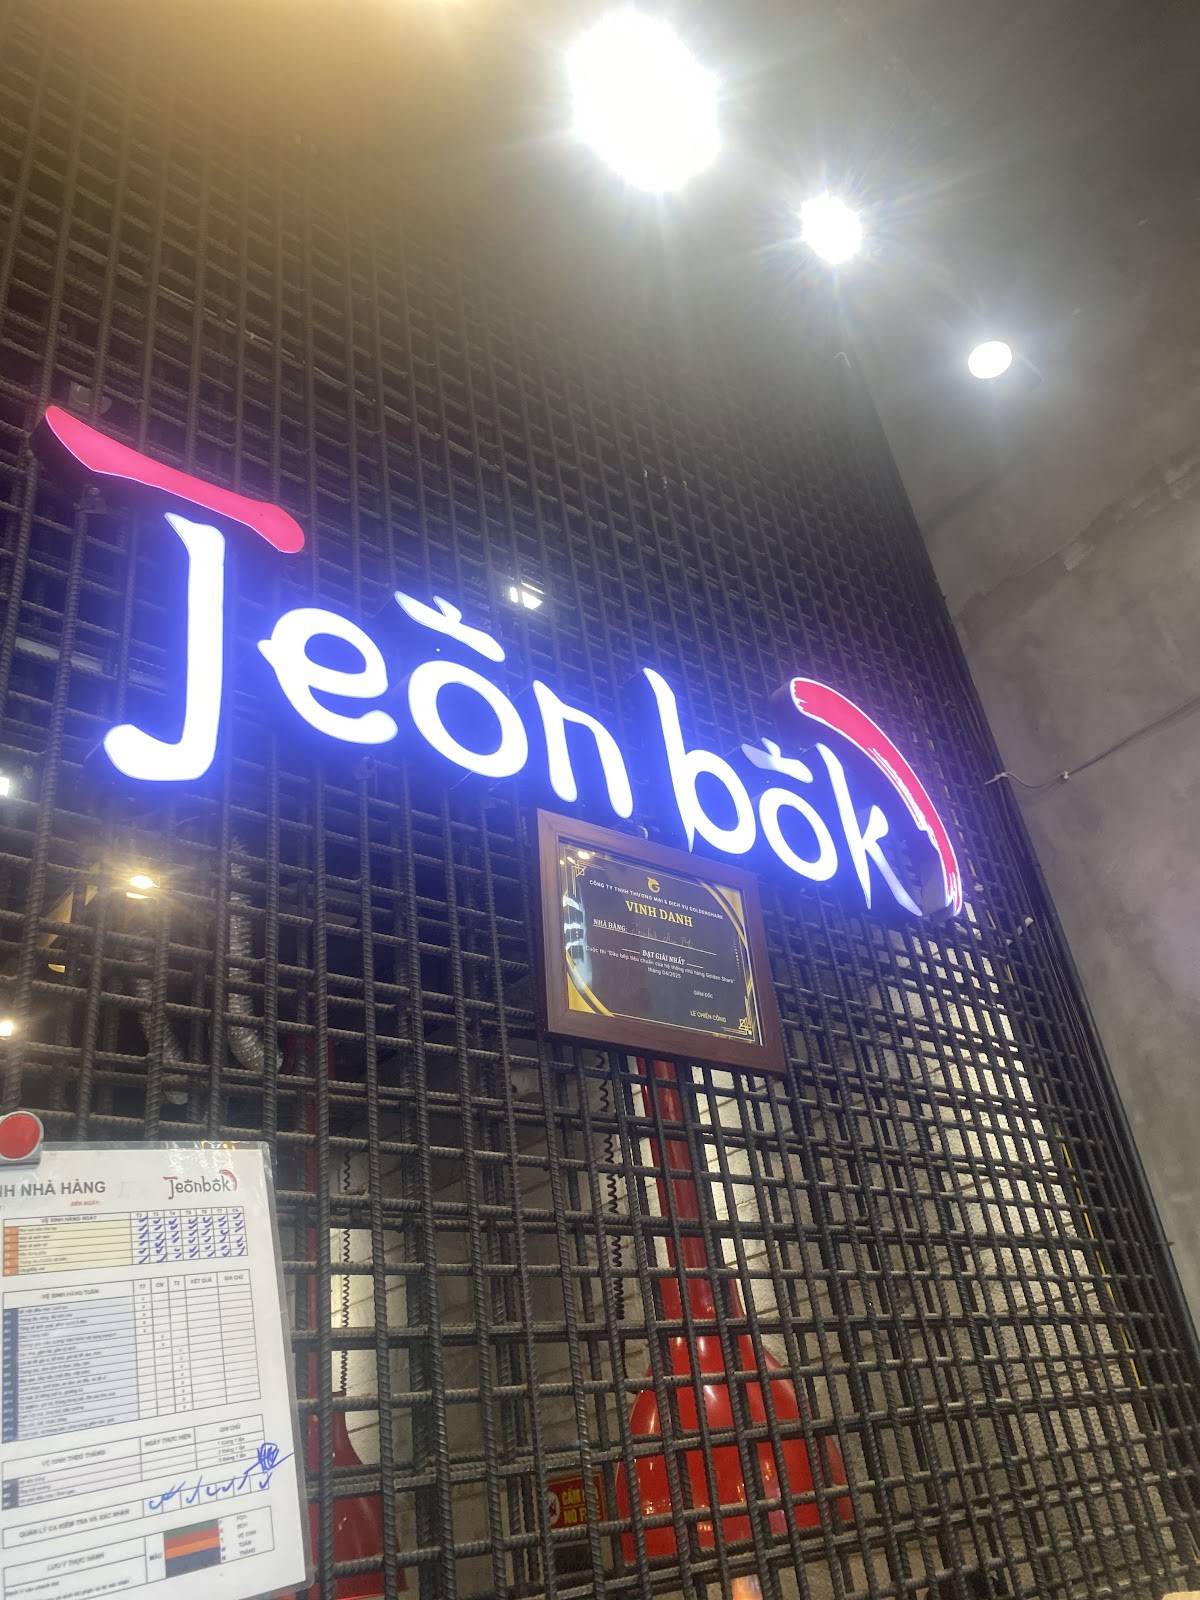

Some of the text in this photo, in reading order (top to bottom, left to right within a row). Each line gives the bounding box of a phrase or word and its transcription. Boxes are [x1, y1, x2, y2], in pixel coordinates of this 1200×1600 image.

[625, 900, 693, 927] VINH DANH
[593, 918, 607, 928] NHÀ
